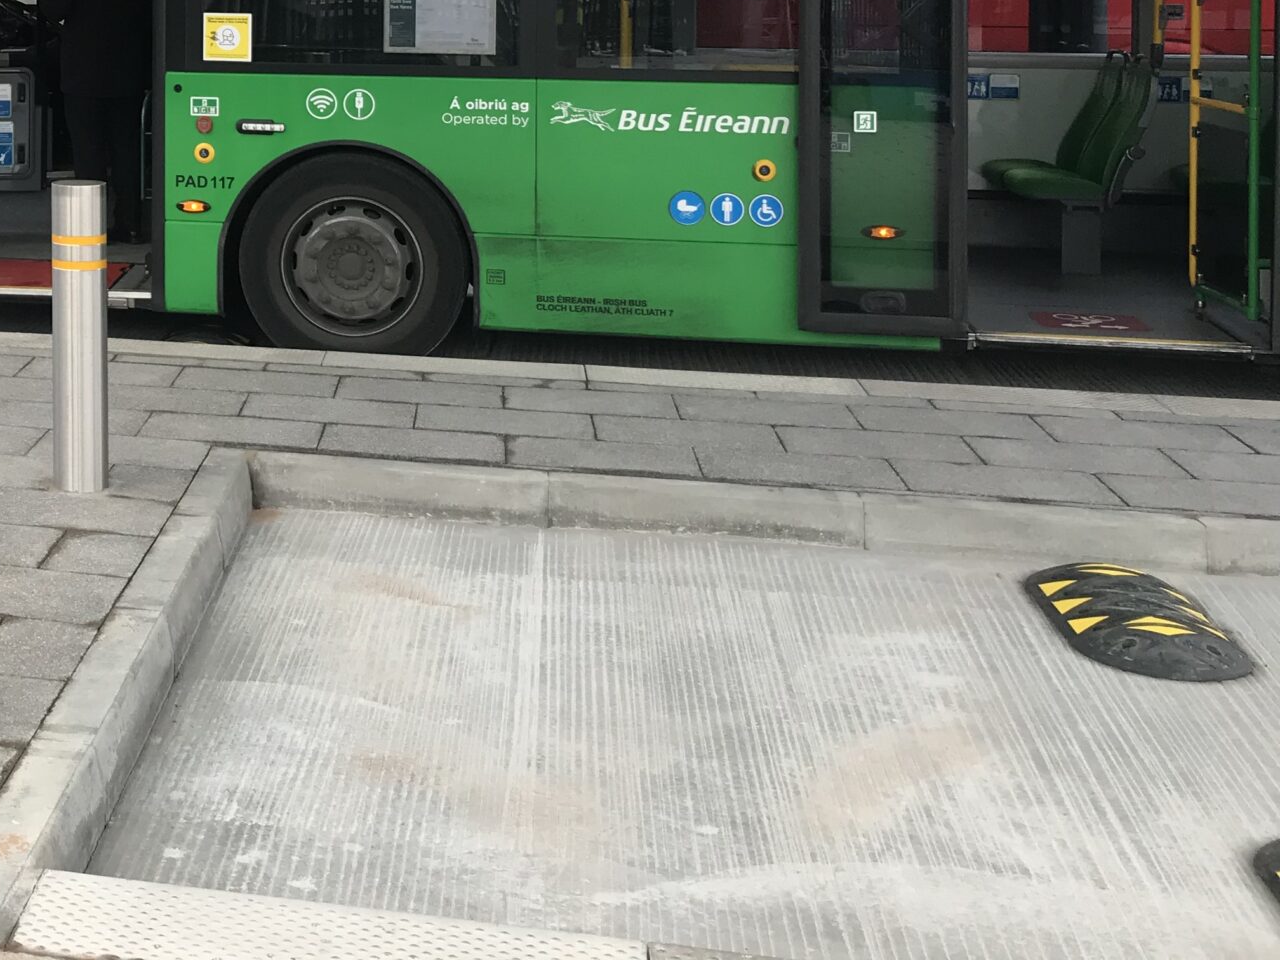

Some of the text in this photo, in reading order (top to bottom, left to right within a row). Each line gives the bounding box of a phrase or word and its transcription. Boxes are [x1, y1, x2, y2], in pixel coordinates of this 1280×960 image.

[449, 95, 530, 114] Á oibriú ag
[441, 112, 530, 129] Operated by
[618, 109, 672, 133] Bus
[536, 295, 555, 303] BUS
[602, 298, 627, 307] IRISH
[628, 299, 648, 308] BUS
[535, 303, 567, 312] CLOCH
[634, 307, 667, 317] CLIATH
[668, 309, 675, 318] 7
